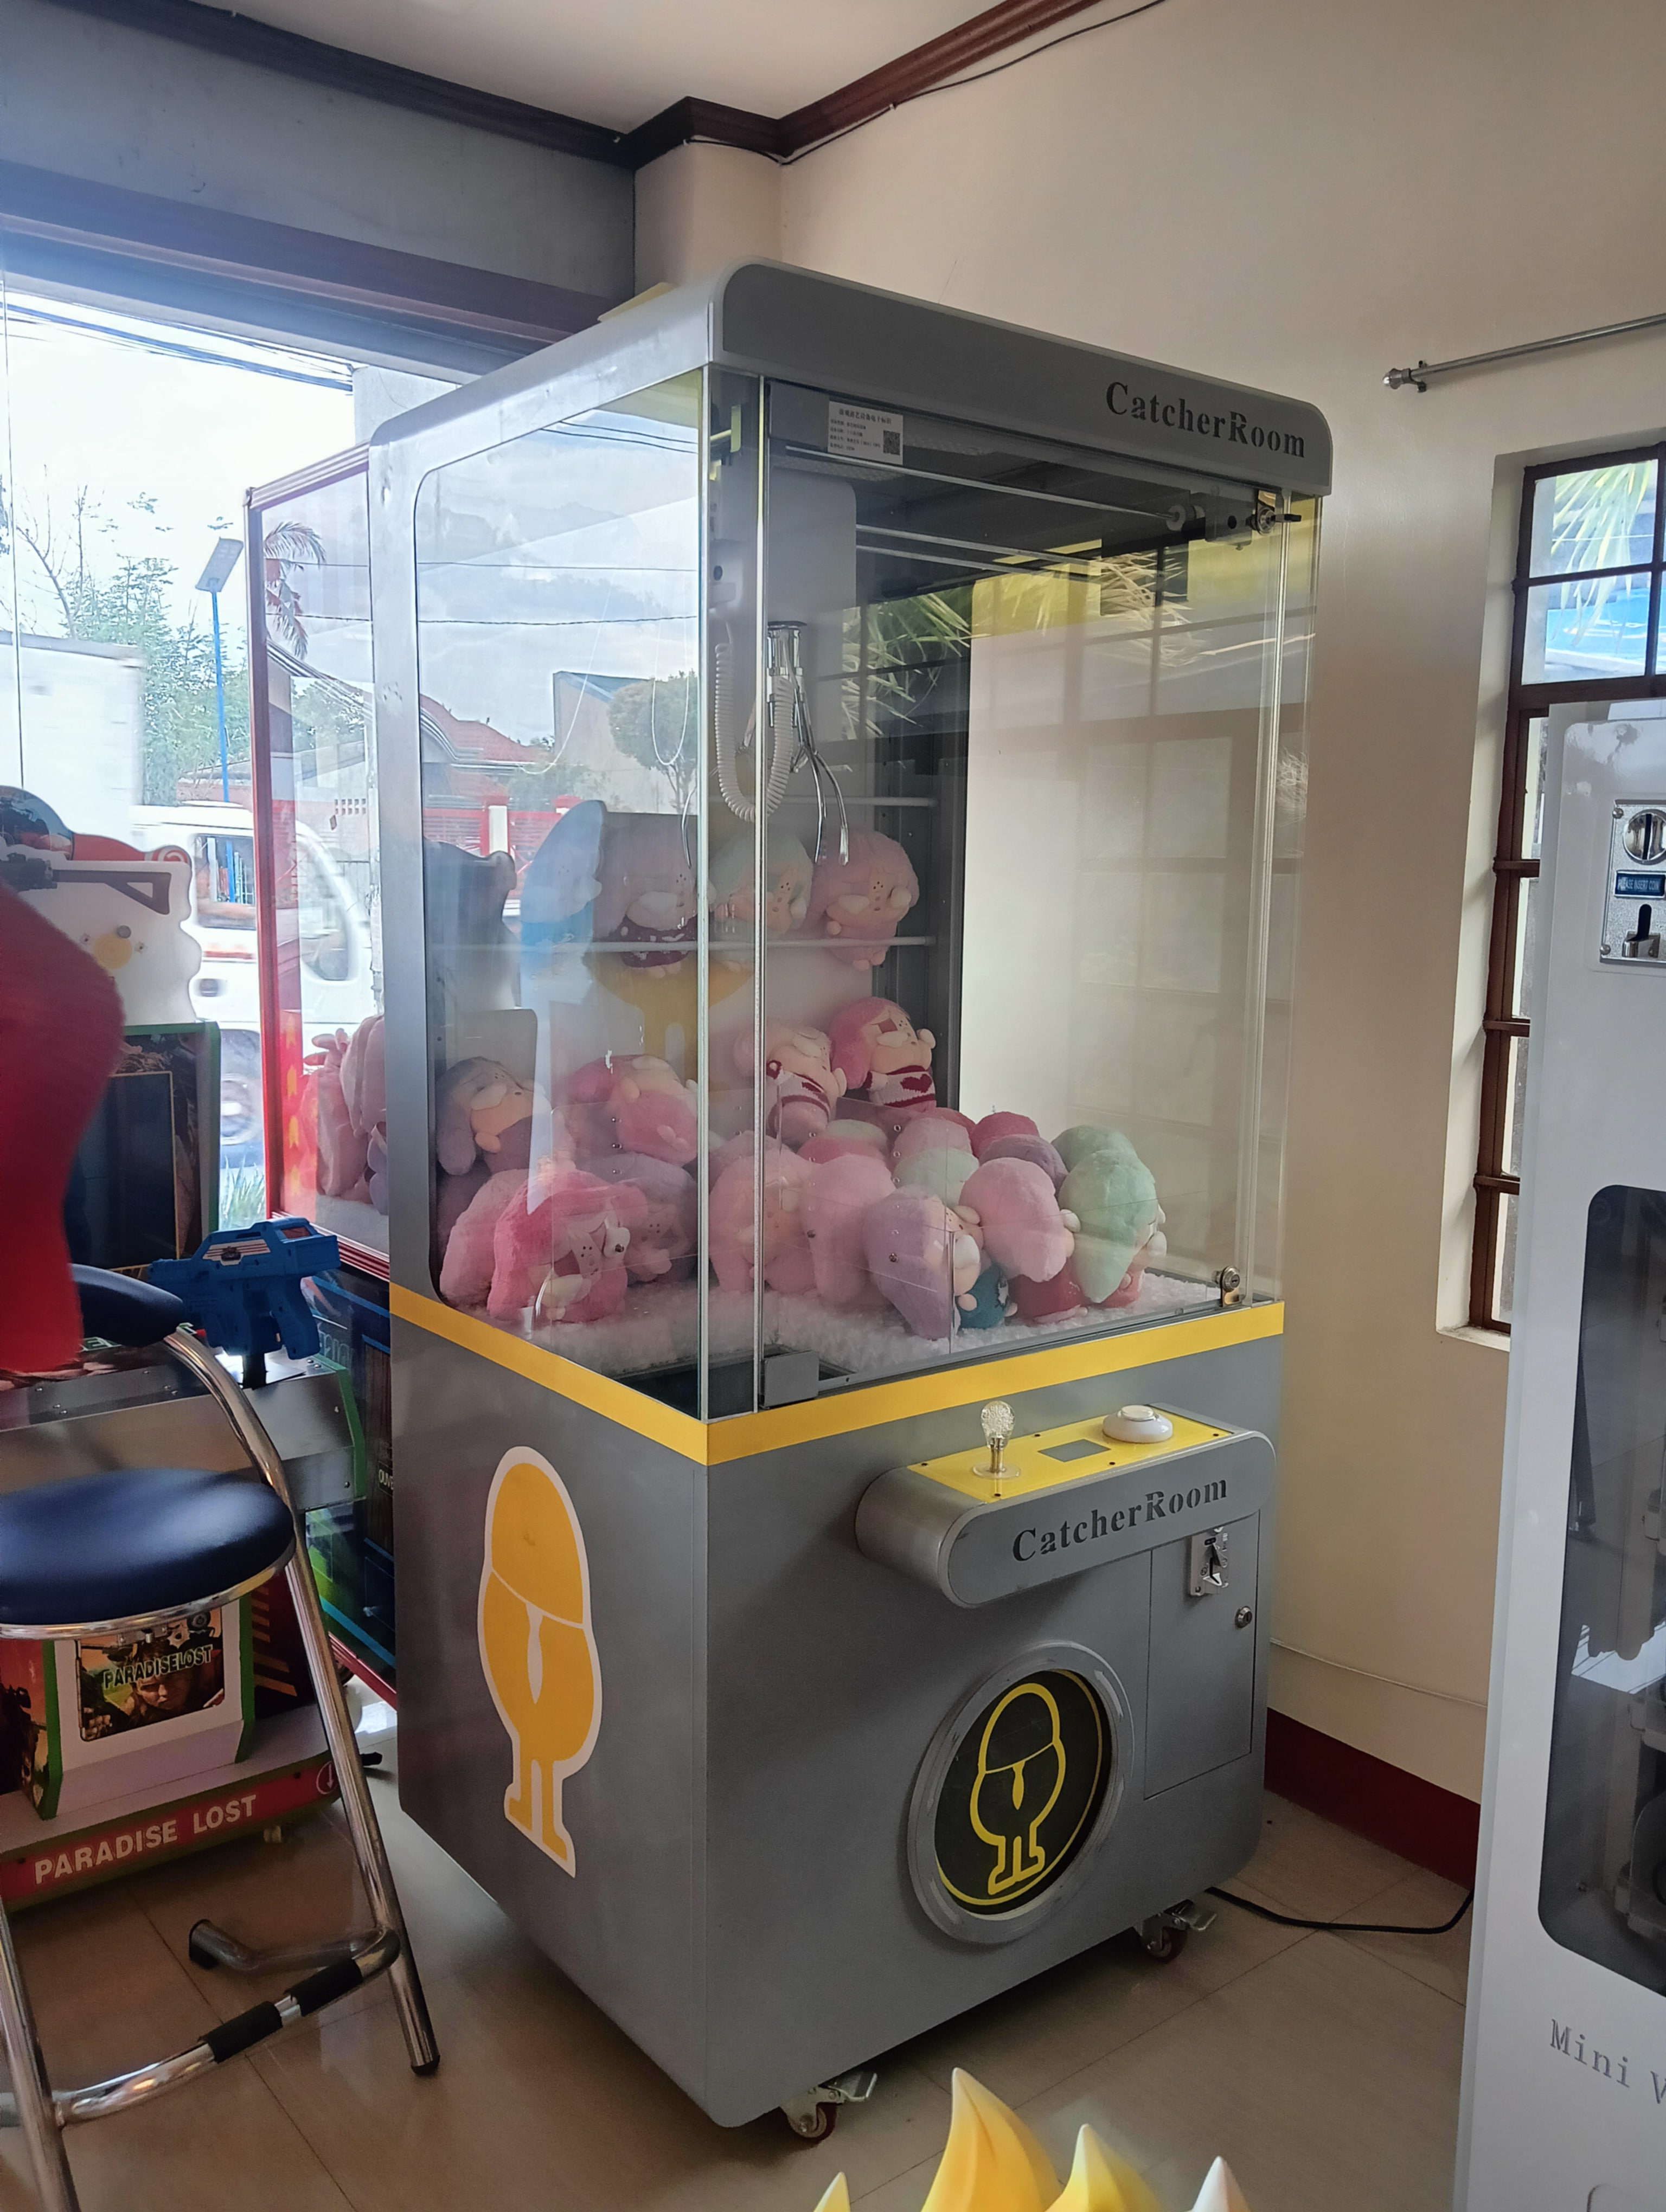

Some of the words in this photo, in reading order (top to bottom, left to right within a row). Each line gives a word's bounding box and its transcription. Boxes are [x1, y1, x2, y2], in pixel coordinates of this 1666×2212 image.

[1106, 382, 1305, 458] CatcherRoom
[1013, 1479, 1227, 1561] CatcherRoom
[35, 1819, 178, 1885] PARADISE
[192, 1795, 257, 1834] LOST
[1549, 2018, 1630, 2088] Mini
